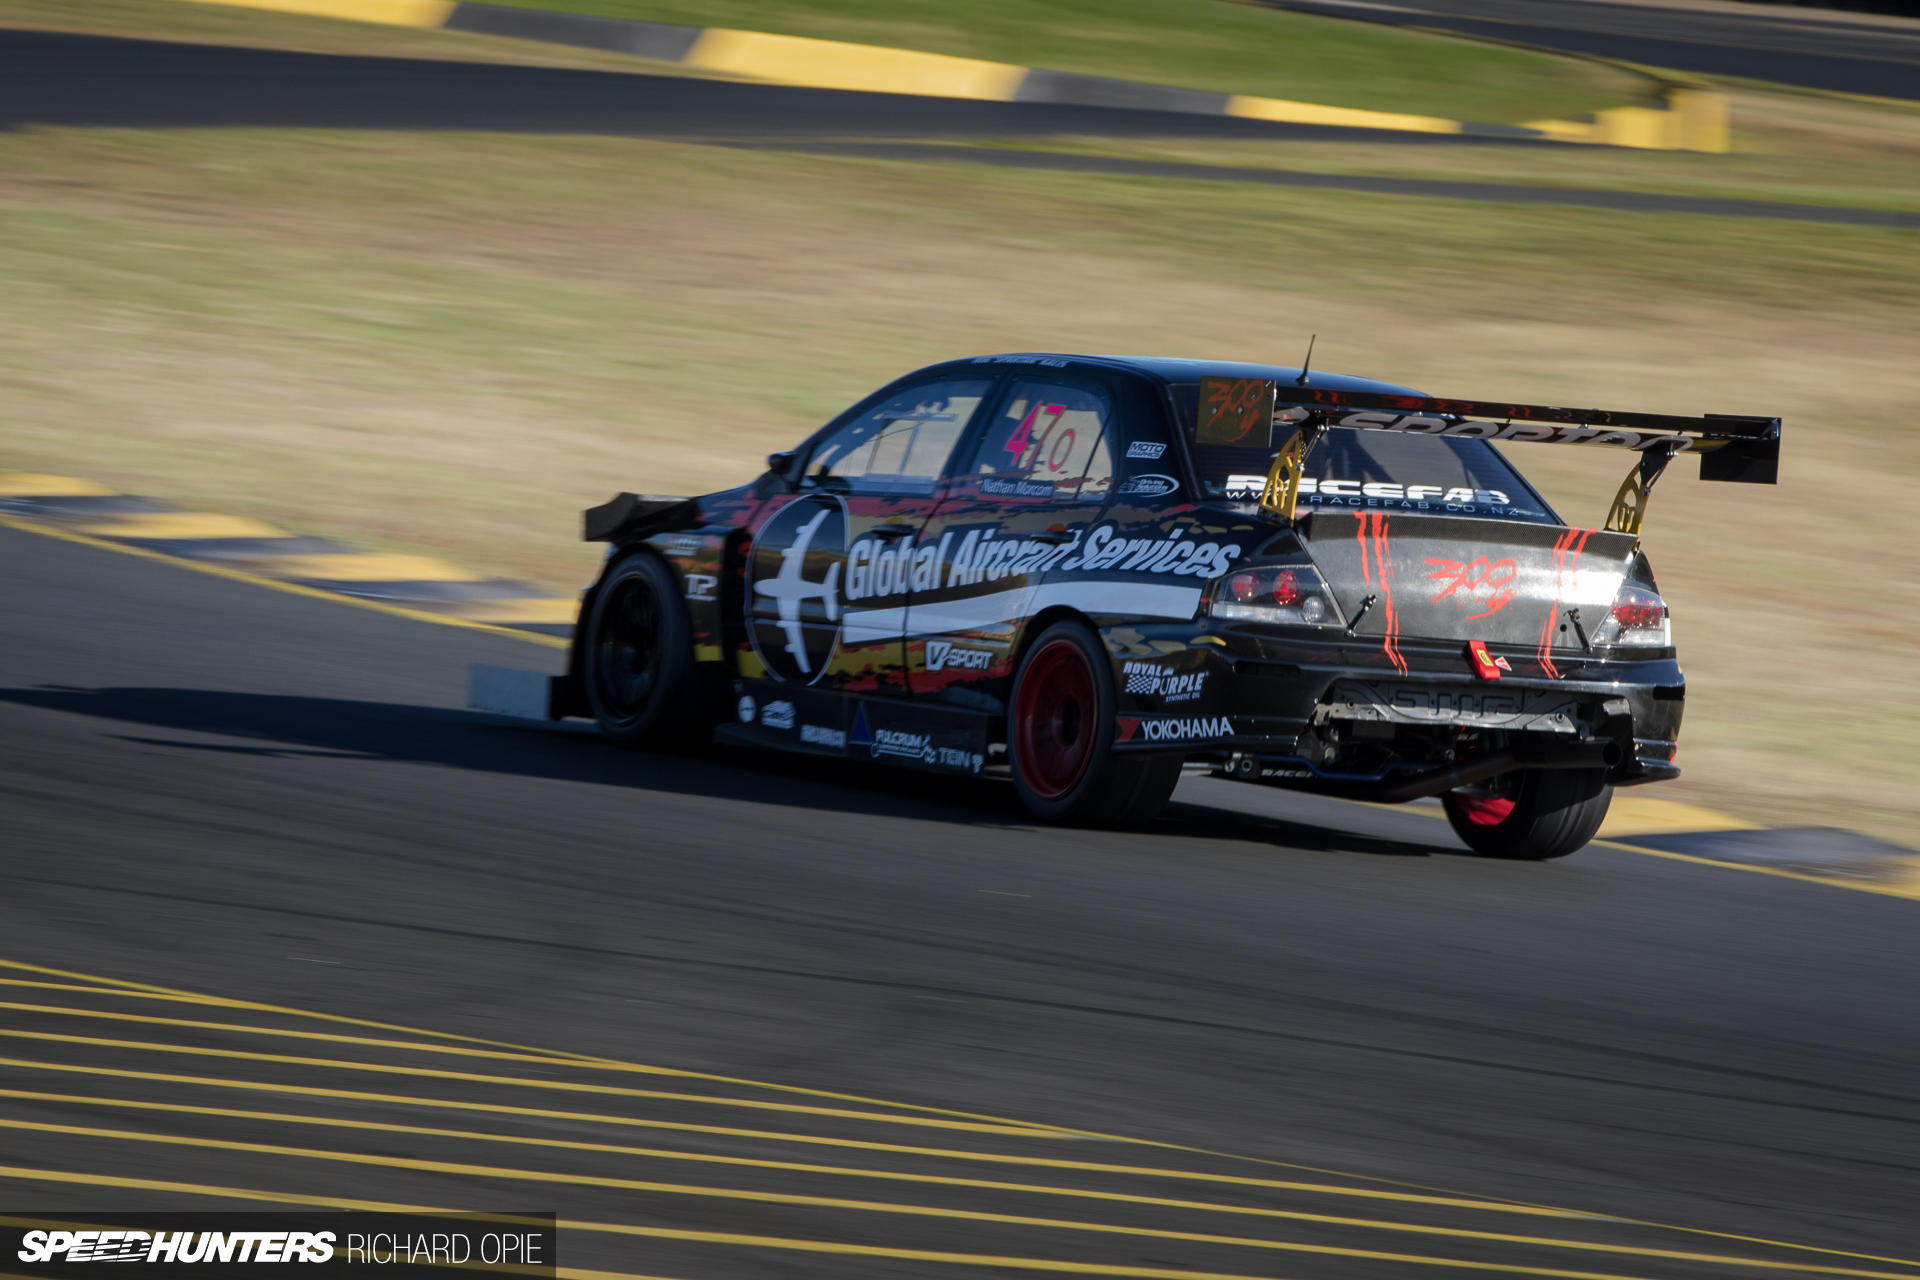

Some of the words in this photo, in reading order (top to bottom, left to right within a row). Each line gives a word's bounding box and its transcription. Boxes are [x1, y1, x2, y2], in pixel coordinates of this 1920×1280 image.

[1130, 443, 1164, 453] MOTO
[980, 478, 1015, 494] Nathan
[845, 532, 950, 600] Global
[947, 528, 1083, 588] Aircraft
[1061, 525, 1241, 578] Services
[1123, 661, 1162, 677] ROYAL
[1149, 671, 1206, 696] PURPLE
[1141, 716, 1235, 740] YOKOHAMA
[875, 729, 922, 748] FULCRUM
[938, 747, 971, 768] TEIN
